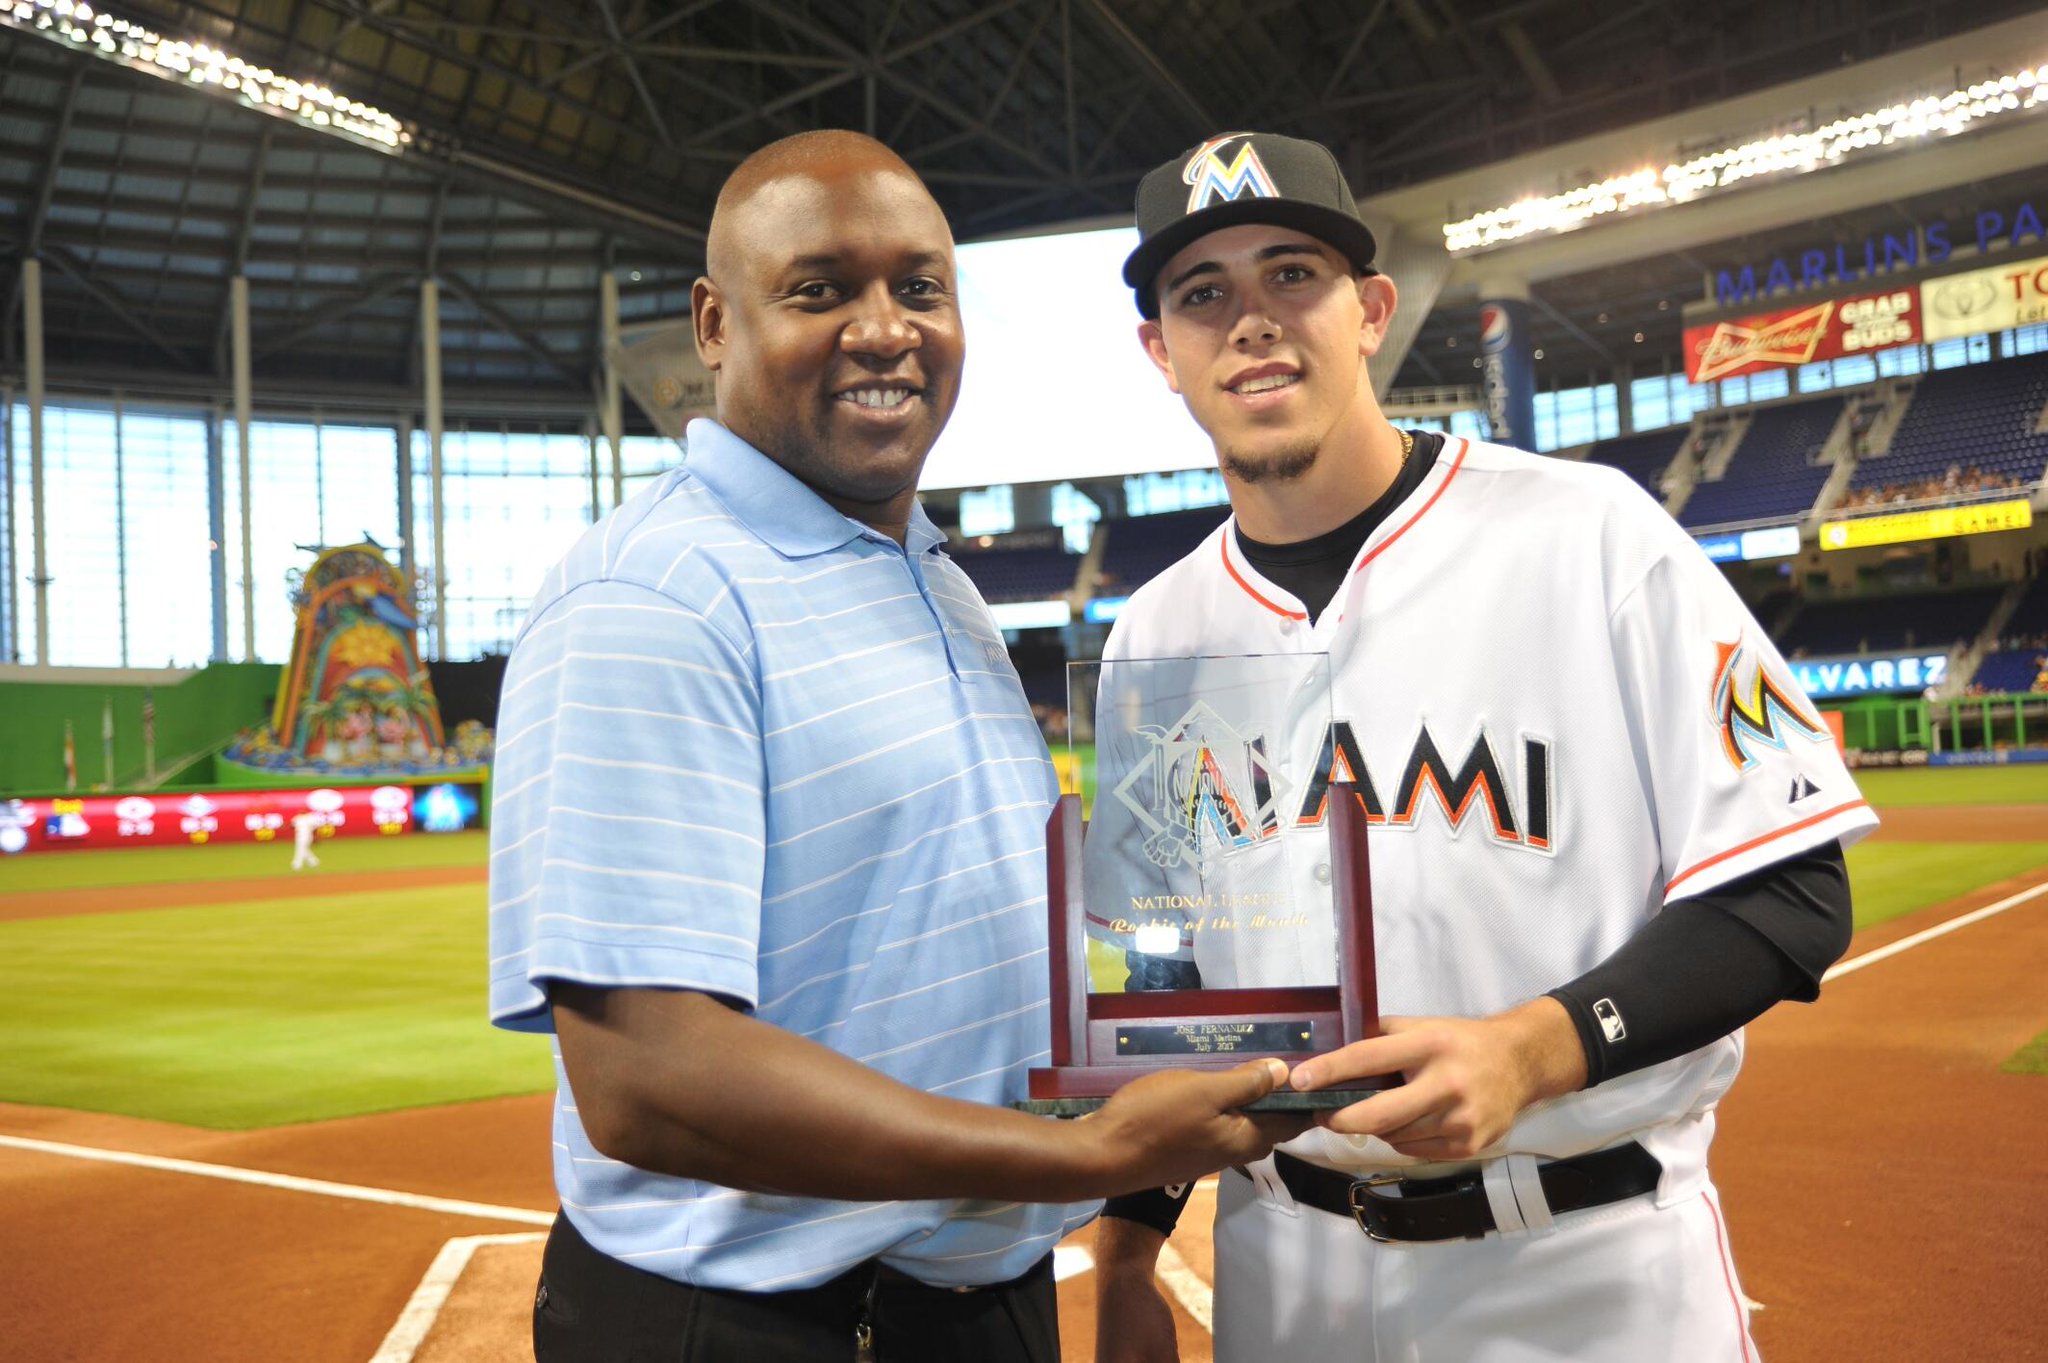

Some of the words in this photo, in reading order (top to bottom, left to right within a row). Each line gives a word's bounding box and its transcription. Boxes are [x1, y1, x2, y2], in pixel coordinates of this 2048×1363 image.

[1716, 220, 1954, 306] MARLINS
[1839, 292, 1911, 325] GRAB
[1842, 319, 1912, 352] BUDS
[1797, 655, 1947, 693] LVAREZ
[1131, 893, 1217, 909] NATIONAL
[1184, 917, 1205, 933] of
[1212, 914, 1239, 930] the
[1200, 1023, 1254, 1034] FERNANDEZ
